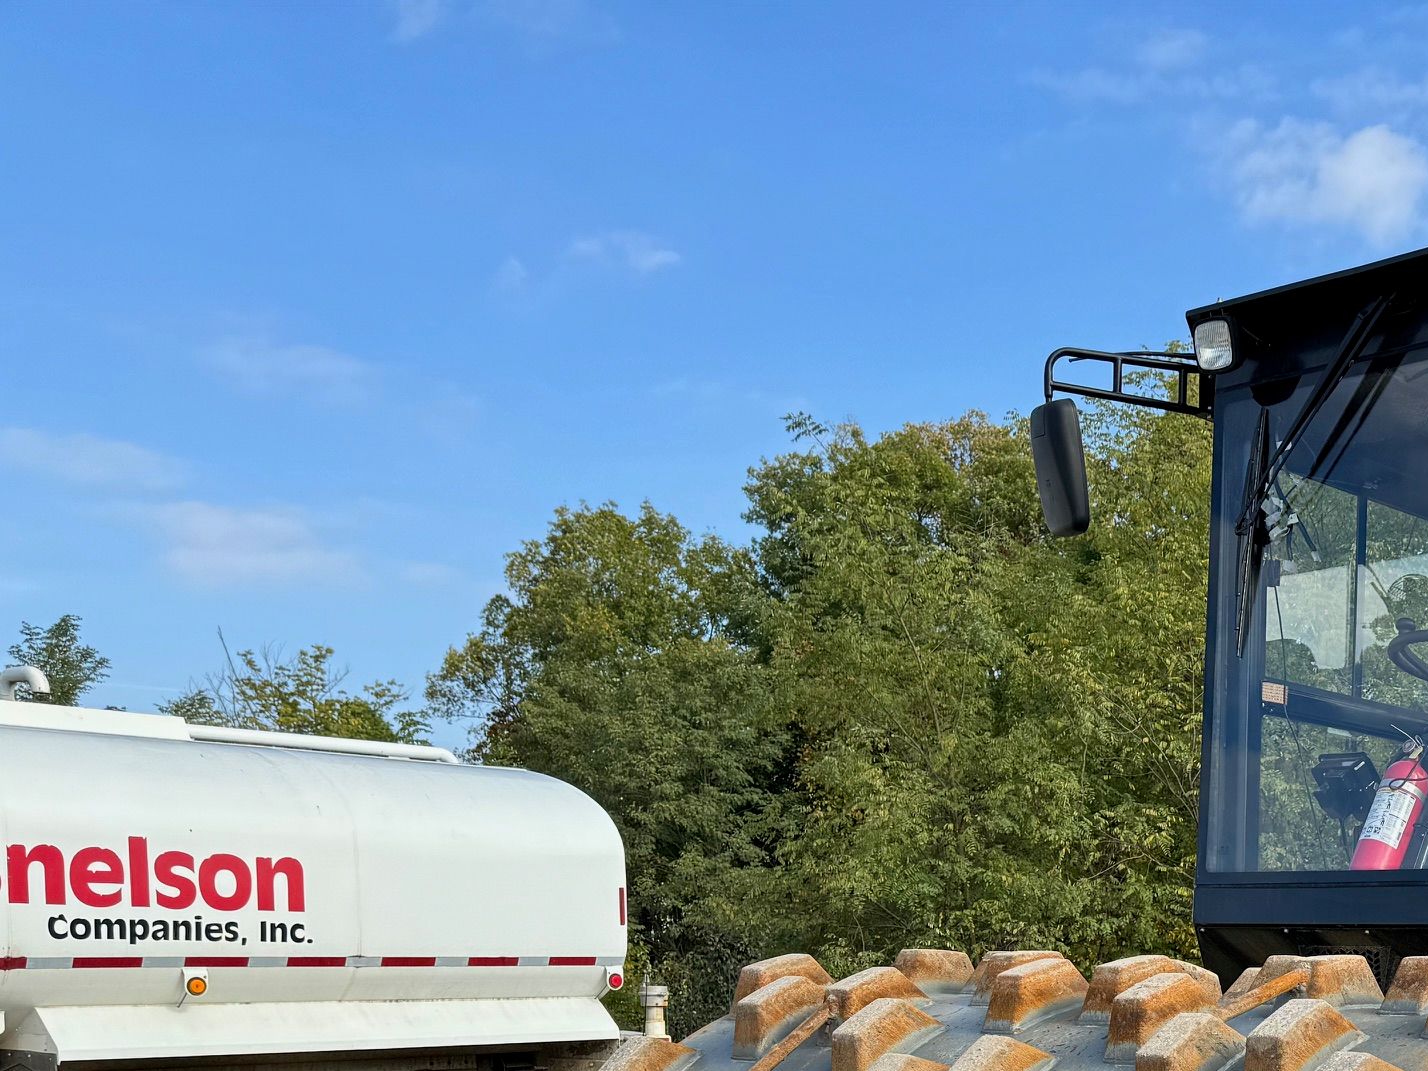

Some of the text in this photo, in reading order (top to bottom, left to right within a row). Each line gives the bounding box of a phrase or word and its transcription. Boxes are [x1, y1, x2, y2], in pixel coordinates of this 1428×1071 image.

[0, 836, 305, 912] nelson
[47, 914, 314, 945] Companies, Inc.
